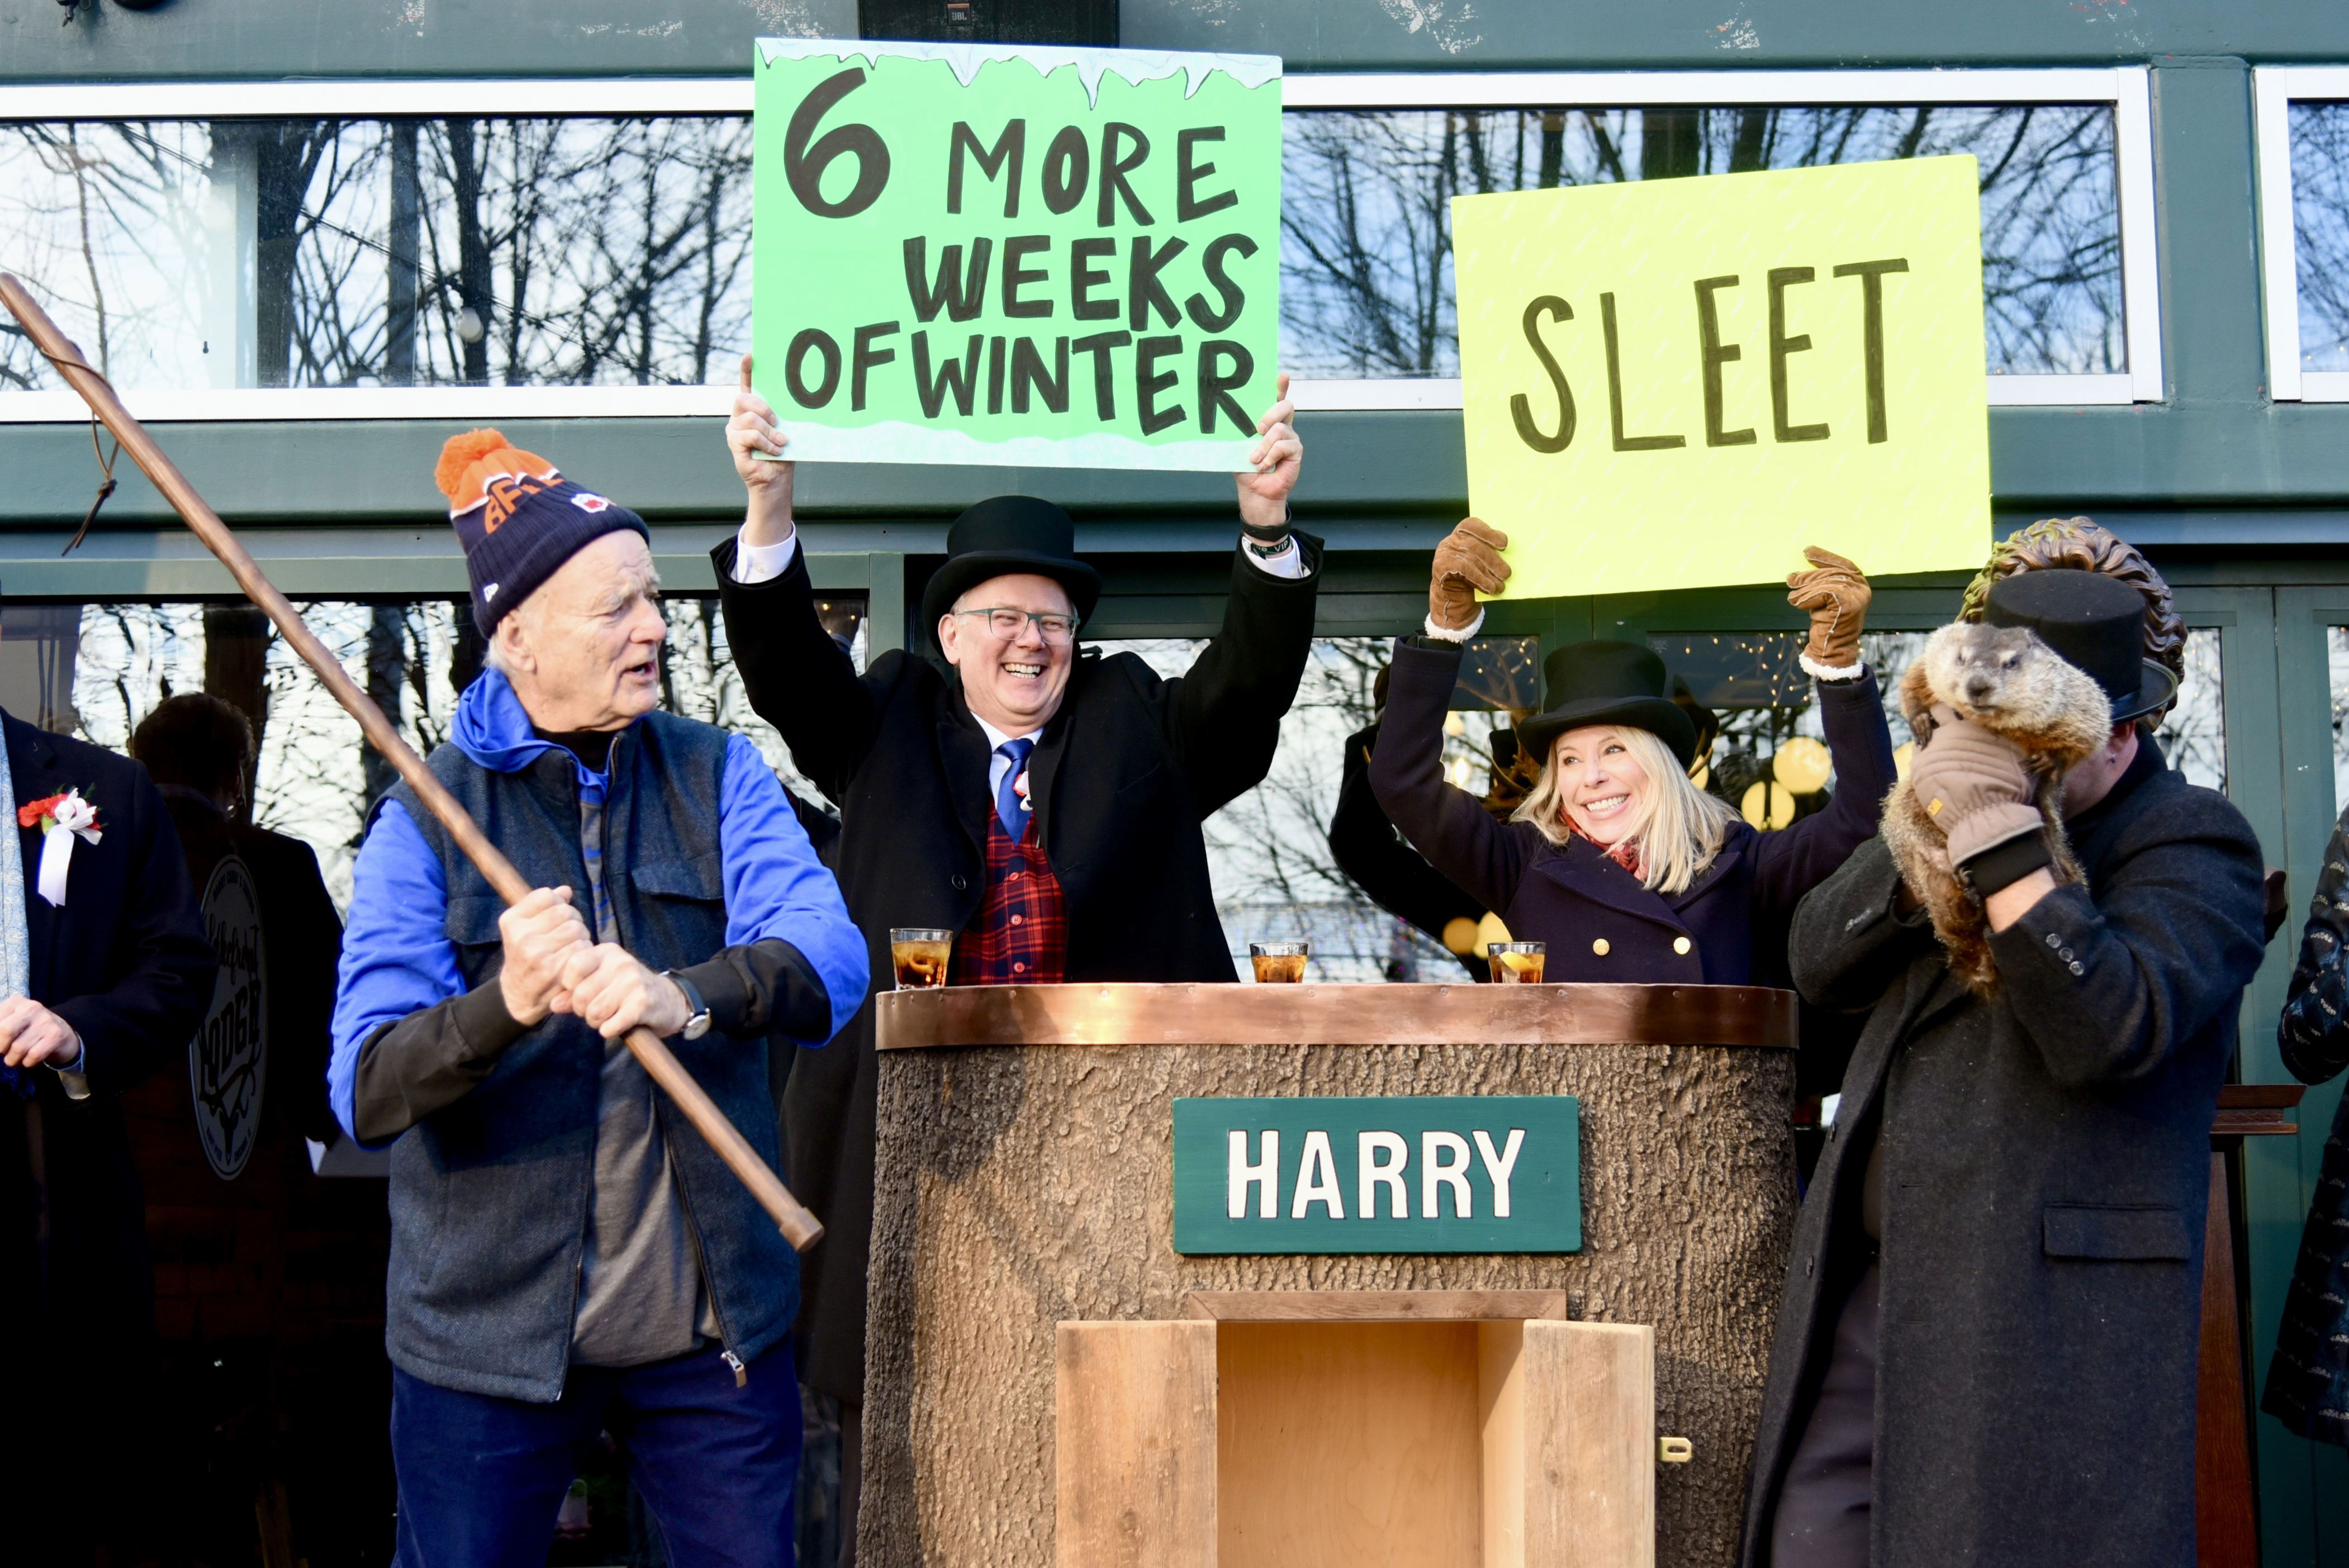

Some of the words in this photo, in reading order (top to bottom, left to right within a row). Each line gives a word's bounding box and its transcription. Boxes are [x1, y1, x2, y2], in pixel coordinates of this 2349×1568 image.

[952, 12, 967, 21] JBL
[784, 66, 891, 218] 6
[946, 118, 1239, 227] MORE
[903, 232, 1259, 334] WEEKS
[785, 320, 901, 412] OF
[910, 329, 1259, 438] WINTER
[1510, 257, 1910, 454] SLEET
[1274, 540, 1288, 552] VIP
[1227, 1128, 1527, 1219] HARRY
